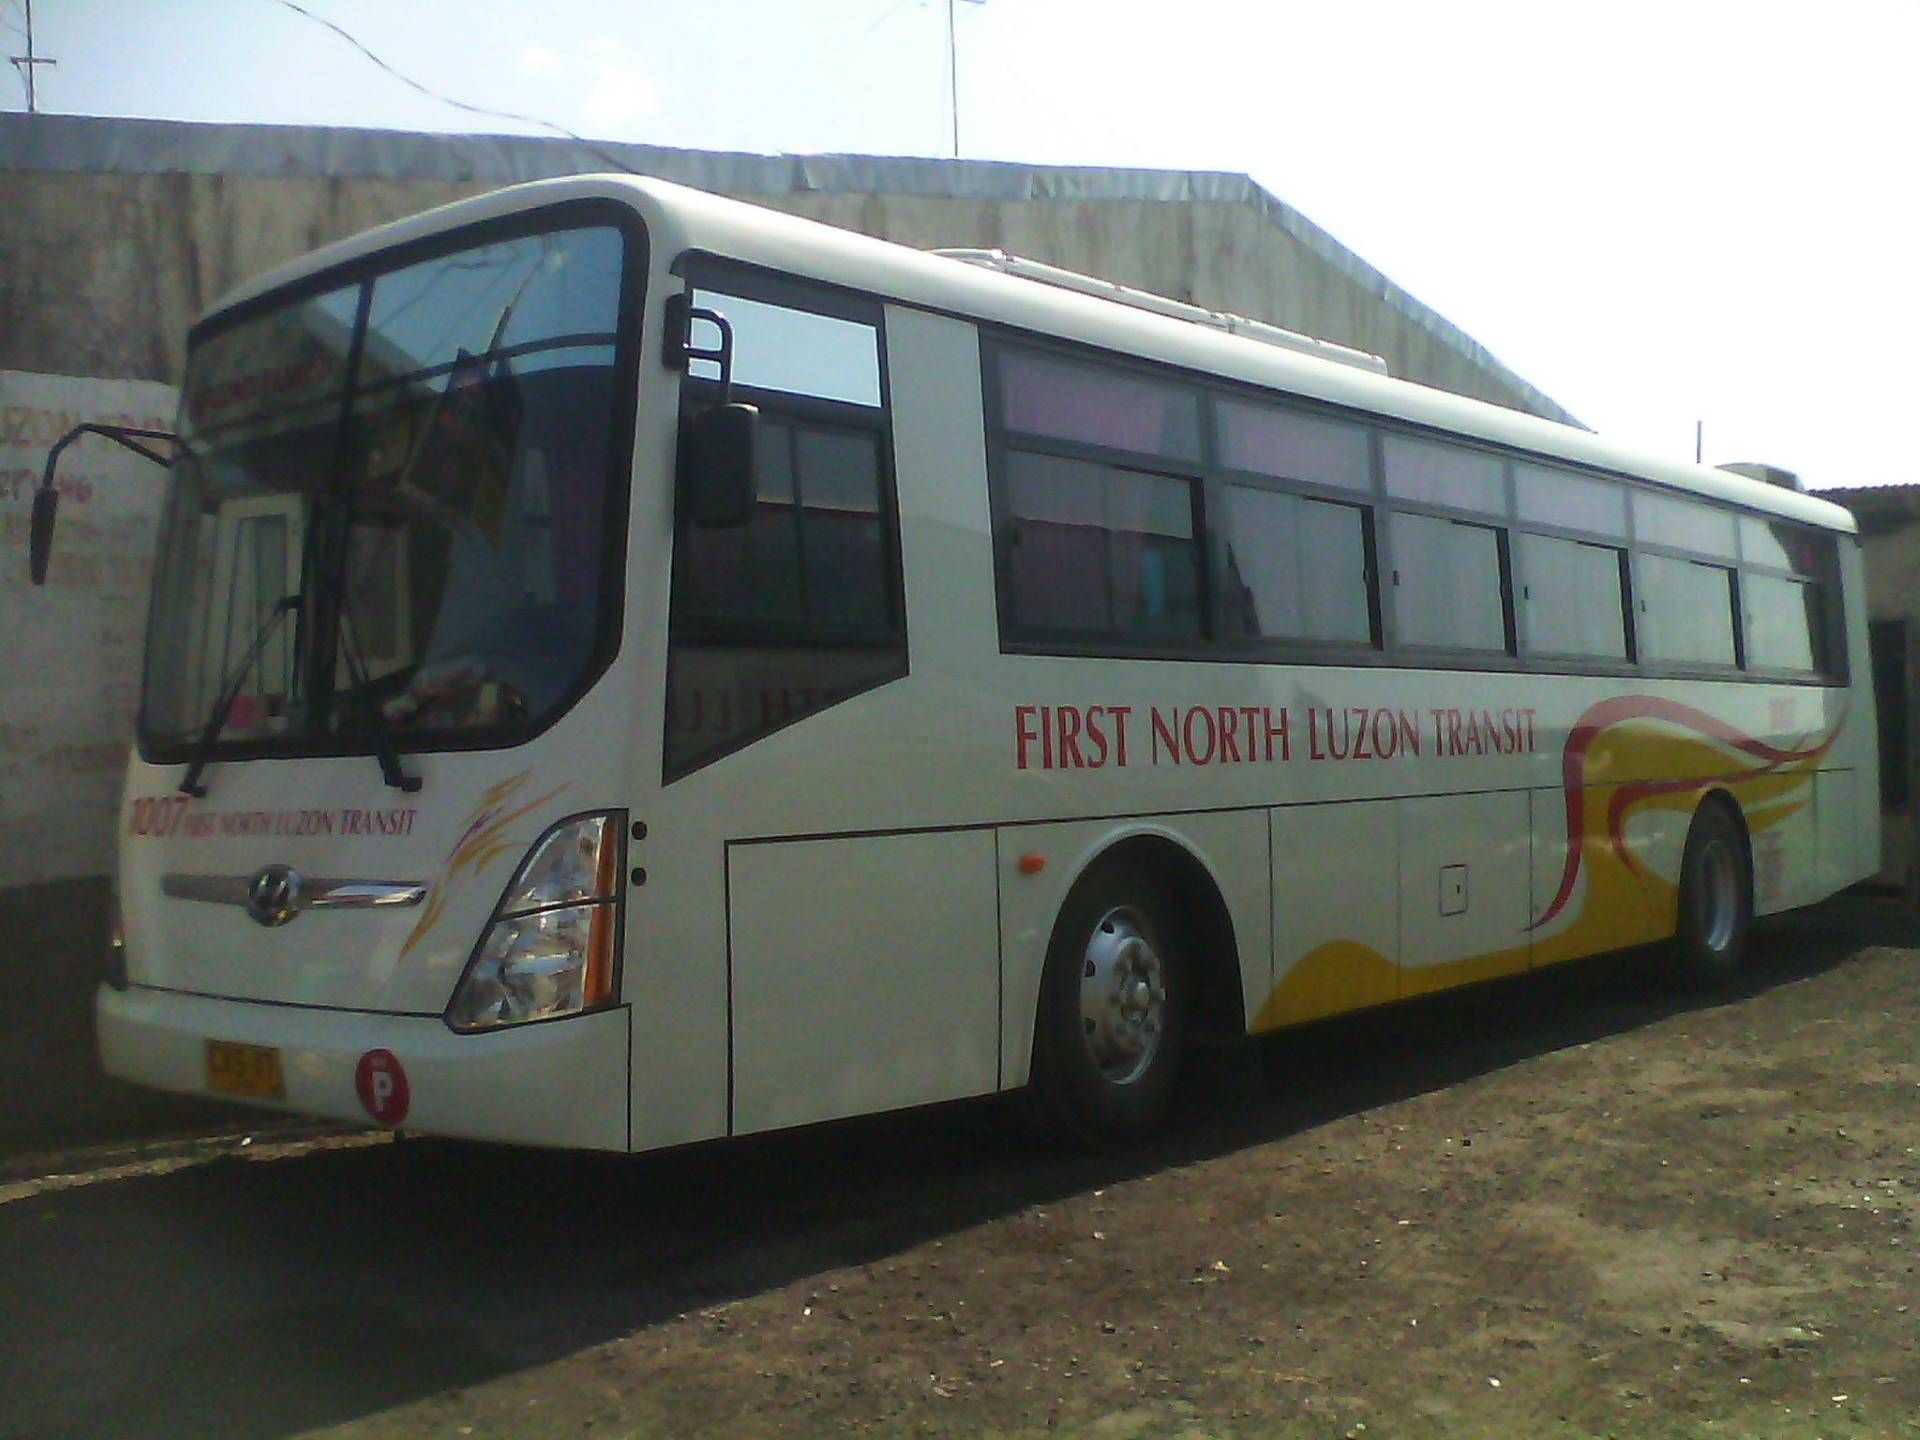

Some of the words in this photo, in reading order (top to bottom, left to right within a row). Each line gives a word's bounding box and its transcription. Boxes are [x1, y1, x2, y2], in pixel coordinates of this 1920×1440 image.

[1014, 704, 1132, 770] FIRST
[1150, 705, 1291, 766] NORTH
[1307, 706, 1422, 762] LUZON
[1429, 707, 1537, 757] TRANSIT
[338, 808, 418, 836] TRANSIT
[371, 1070, 394, 1113] P
